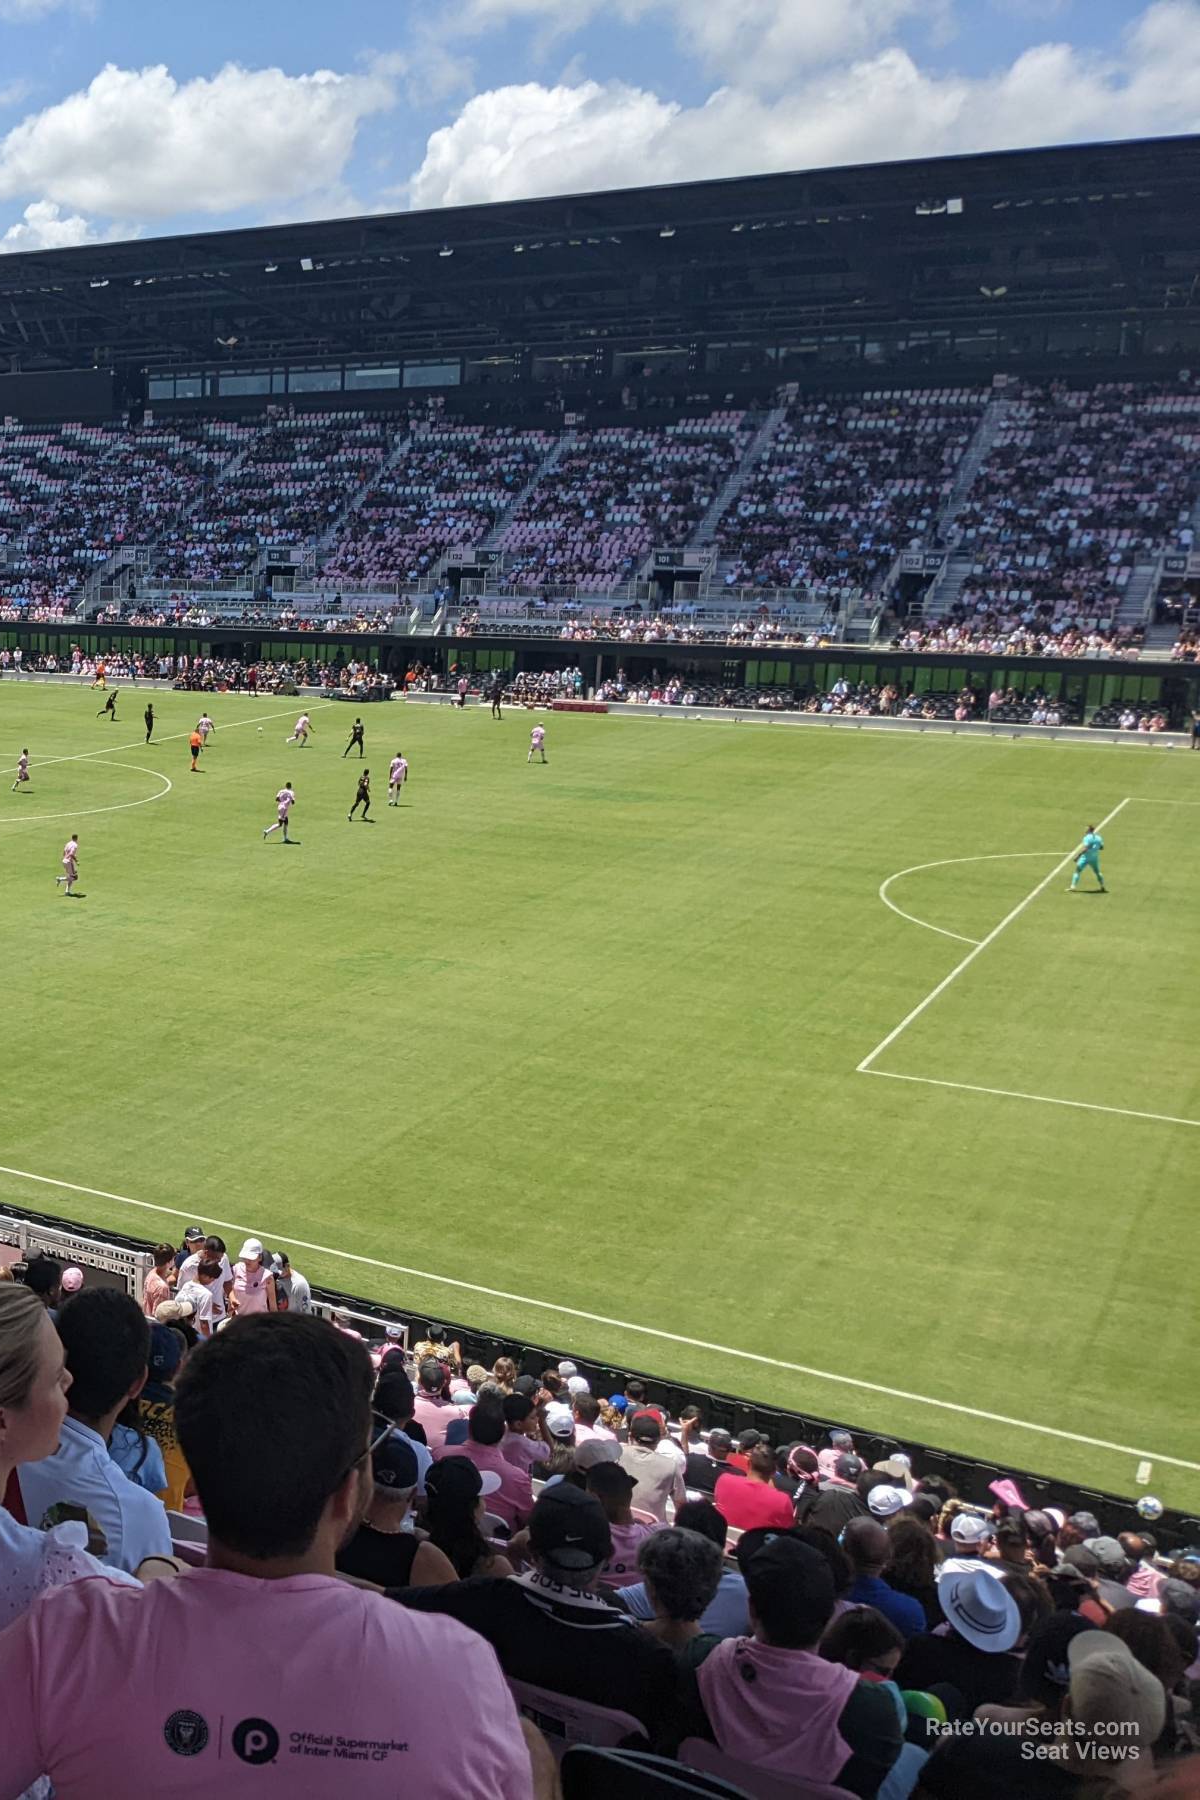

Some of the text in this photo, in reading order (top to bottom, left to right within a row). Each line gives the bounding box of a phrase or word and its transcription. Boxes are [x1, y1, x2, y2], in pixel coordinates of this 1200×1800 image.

[925, 558, 941, 566] 103
[289, 1732, 409, 1752] Official Supermarket
[289, 1744, 388, 1761] of Inter Miami CF
